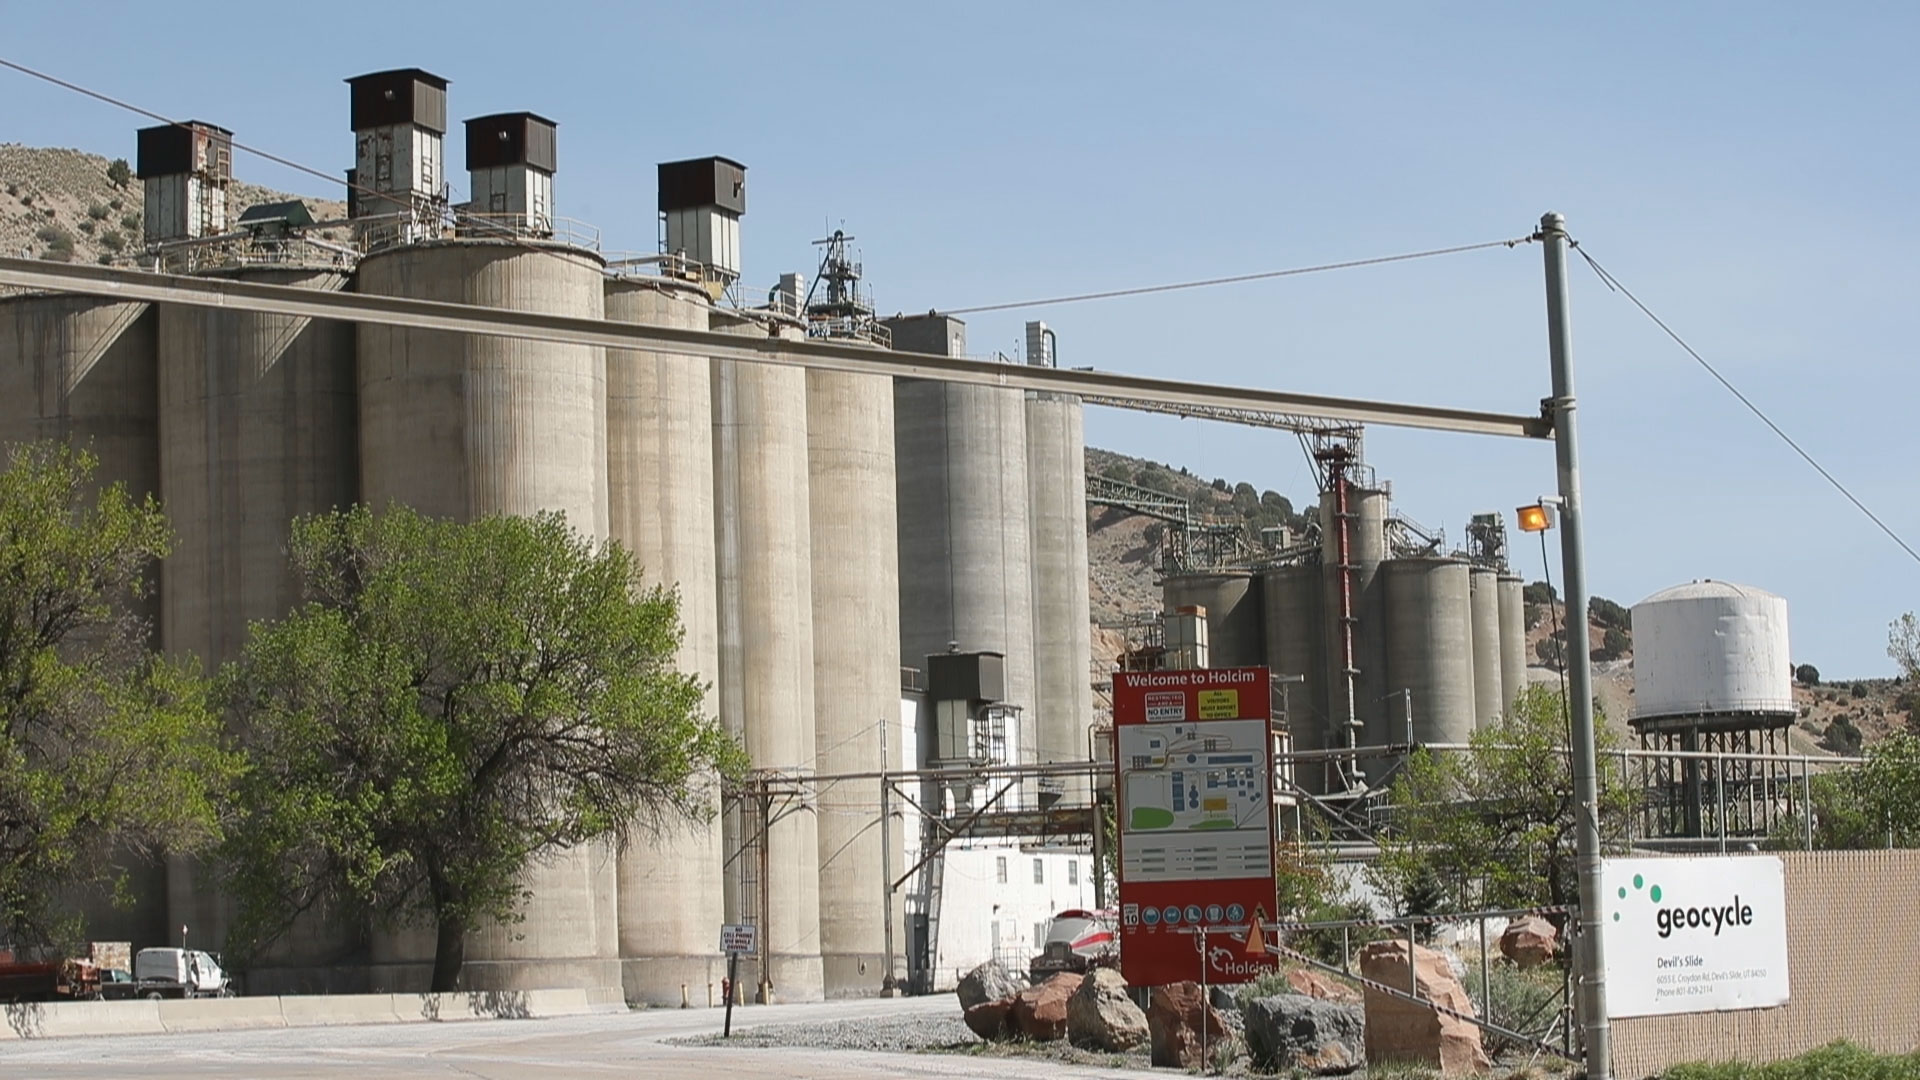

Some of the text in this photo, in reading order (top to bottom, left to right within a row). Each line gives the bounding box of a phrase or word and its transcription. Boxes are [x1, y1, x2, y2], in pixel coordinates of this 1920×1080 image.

[1126, 670, 1255, 687] Welcome to Holcim
[1147, 694, 1183, 702] RESTRICTED
[1148, 707, 1183, 716] NO ENTRY
[1125, 914, 1138, 924] 10
[1656, 894, 1753, 939] geocycle
[1657, 954, 1703, 969] Devil's Slide
[1656, 986, 1675, 997] Phone
